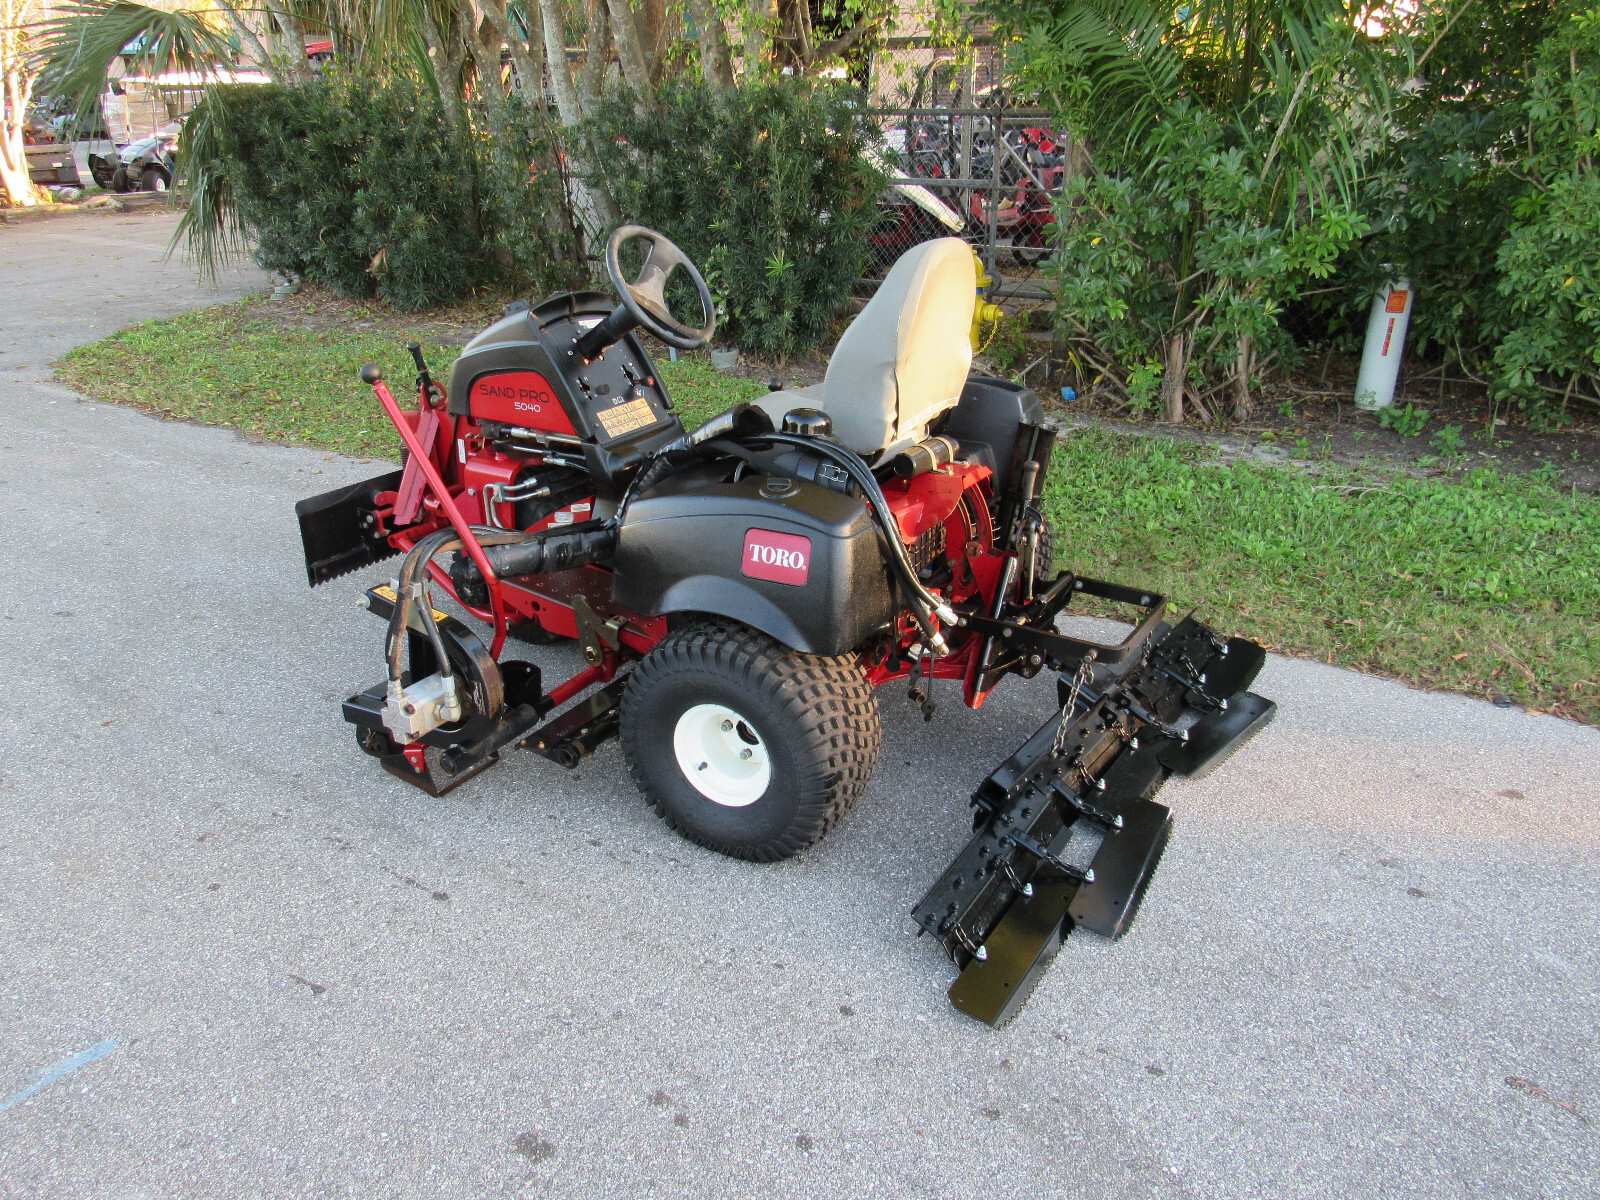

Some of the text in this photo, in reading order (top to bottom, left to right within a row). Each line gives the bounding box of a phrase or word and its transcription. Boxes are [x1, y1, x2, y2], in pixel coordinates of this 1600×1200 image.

[479, 384, 550, 403] SAND PRO
[514, 401, 541, 413] 5040
[749, 543, 805, 570] TORO
